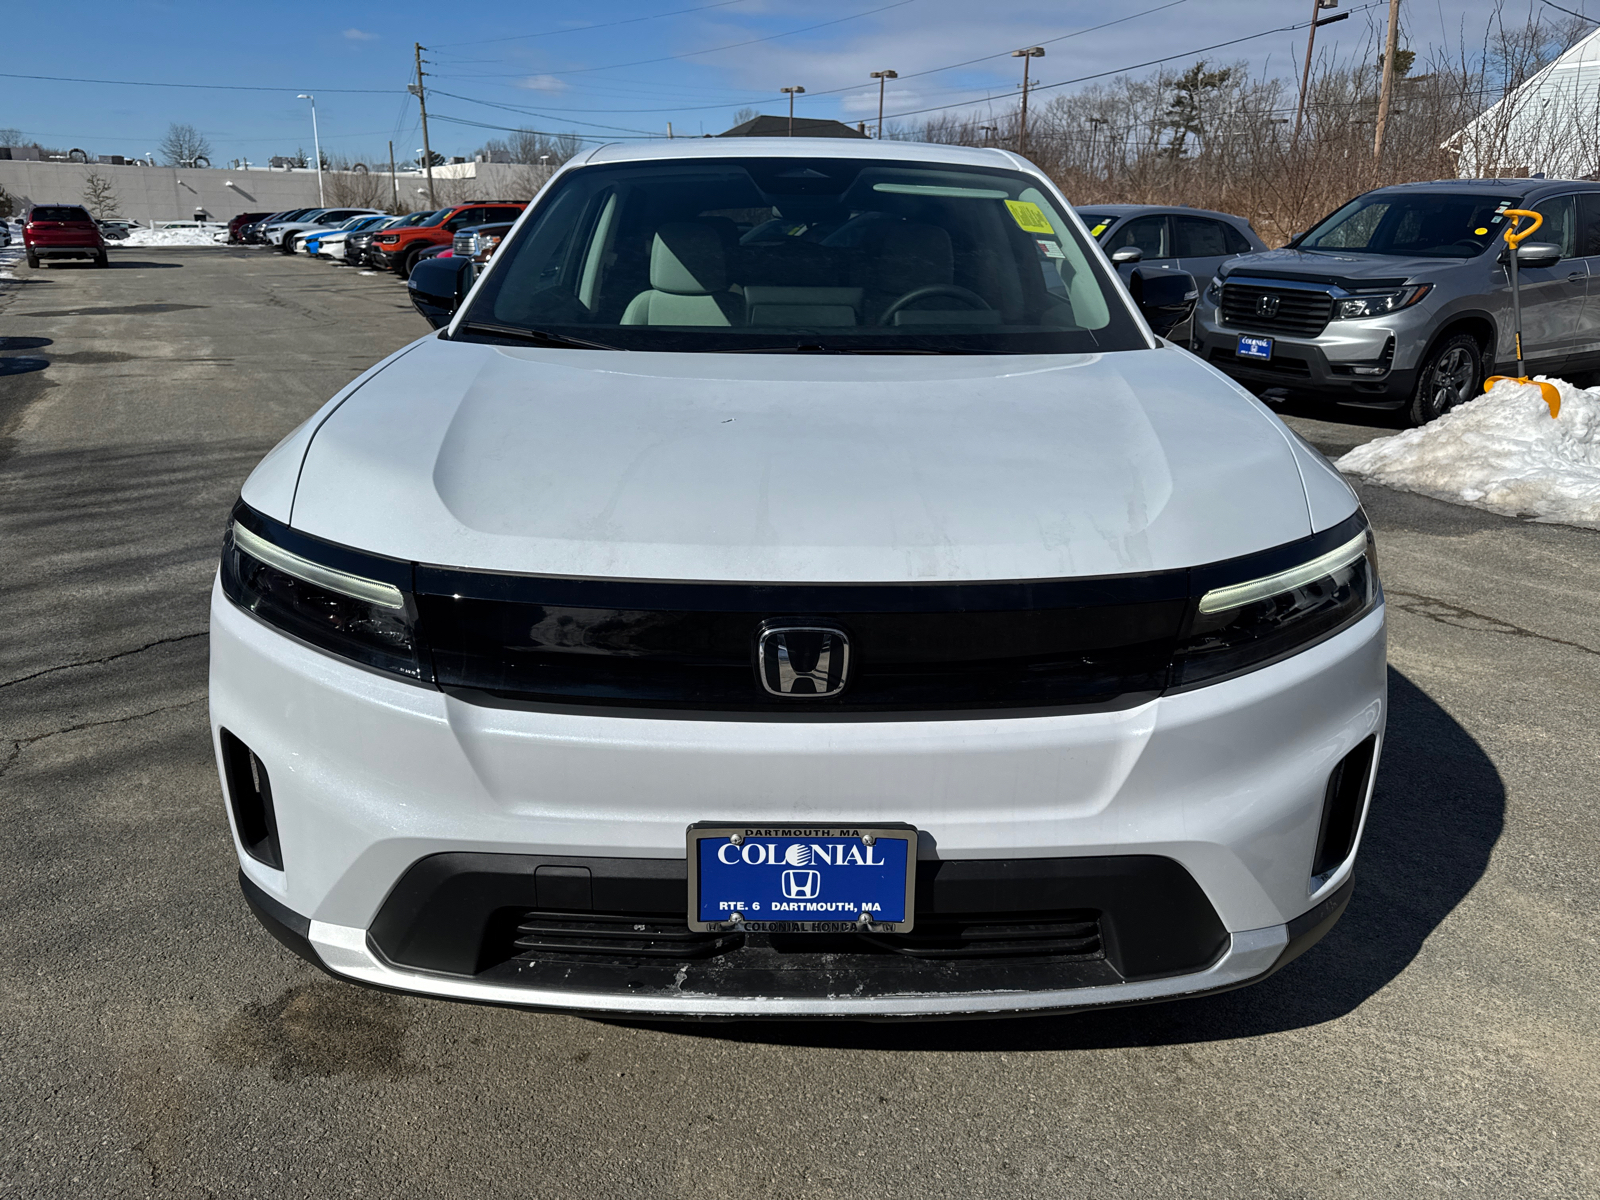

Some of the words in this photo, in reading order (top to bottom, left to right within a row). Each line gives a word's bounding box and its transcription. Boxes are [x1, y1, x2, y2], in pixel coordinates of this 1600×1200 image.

[839, 829, 860, 837] MA
[717, 843, 885, 867] COLONIAL
[719, 901, 749, 911] RTE.
[752, 901, 761, 911] 6
[771, 901, 858, 913] DARTMOUTH,
[861, 902, 882, 912] MA
[744, 921, 809, 932] COLONIAL
